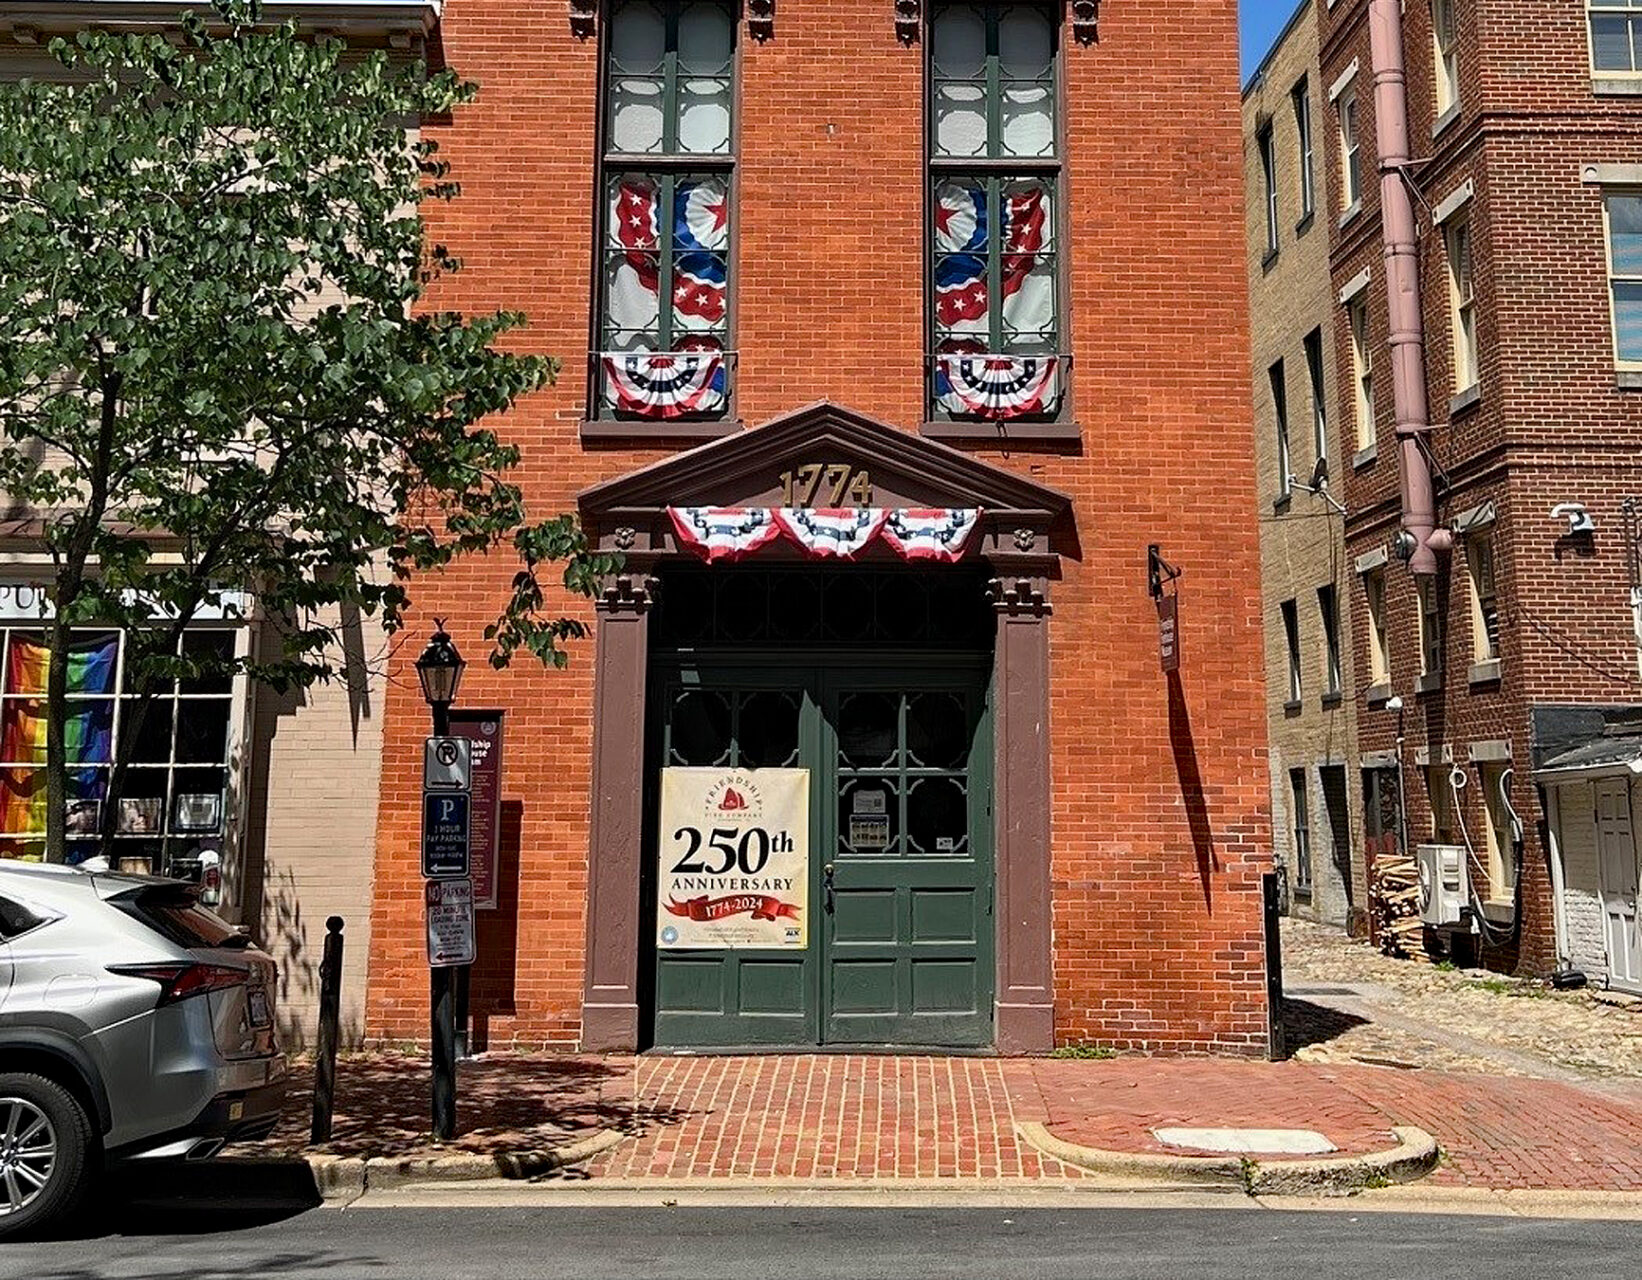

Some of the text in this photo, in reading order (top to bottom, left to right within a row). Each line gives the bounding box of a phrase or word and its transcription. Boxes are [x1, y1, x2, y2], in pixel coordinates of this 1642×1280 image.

[779, 463, 873, 507] 1774
[705, 776, 763, 805] FRIENDSHIP
[440, 799, 455, 822] P
[670, 827, 794, 874] 250th
[428, 885, 469, 901] NO PARKING
[671, 878, 794, 891] ANNIVERSARY
[705, 897, 763, 917] 1774-2024
